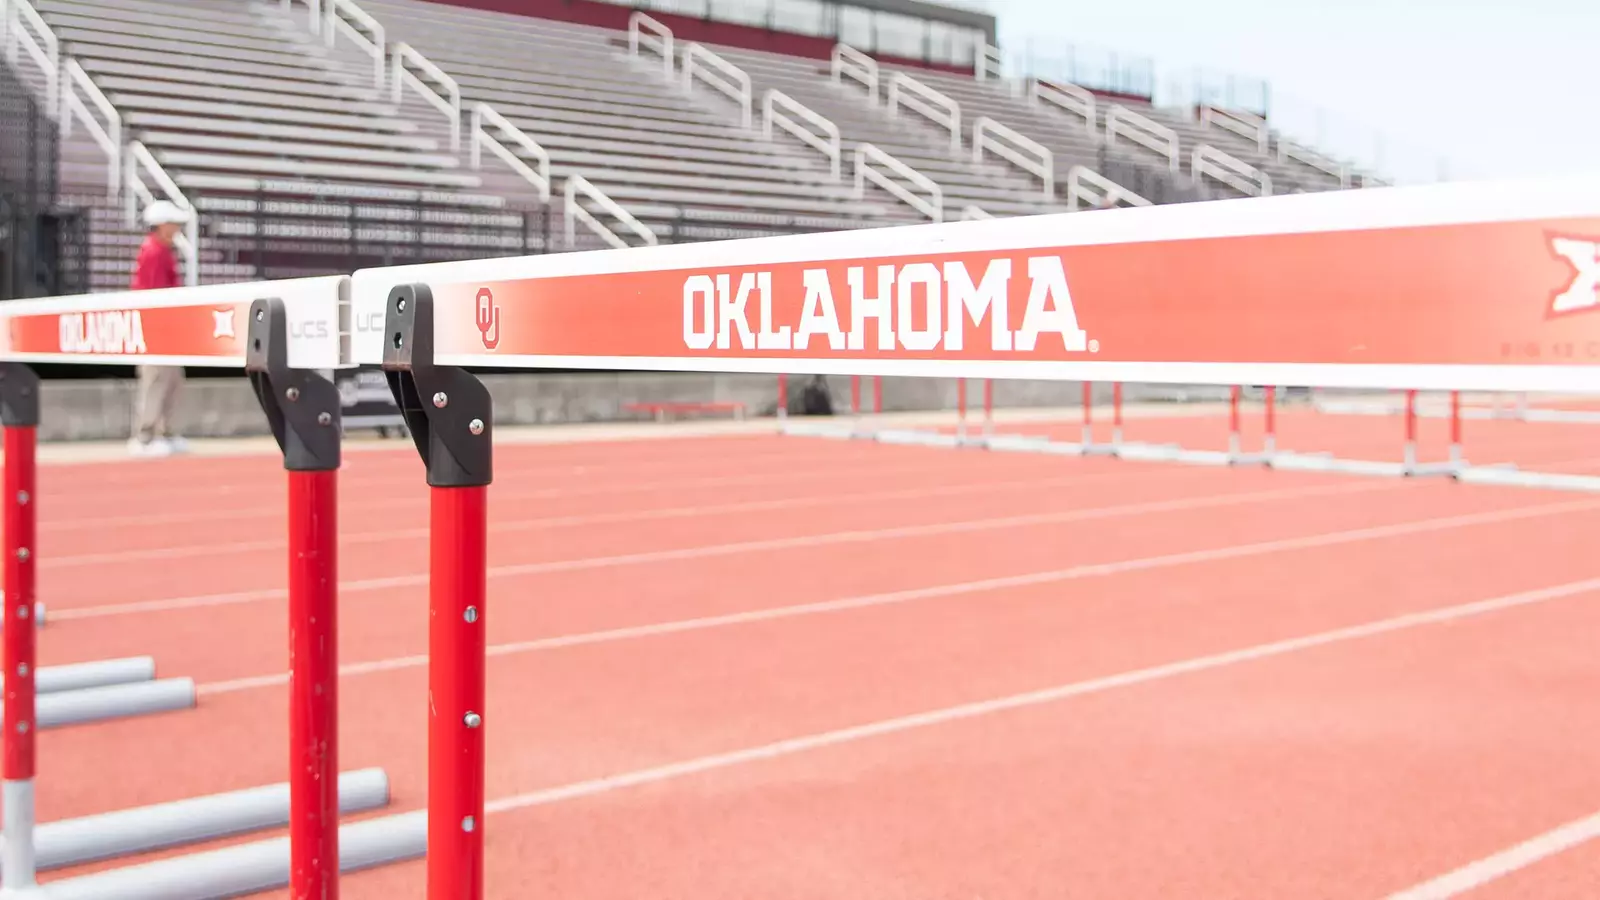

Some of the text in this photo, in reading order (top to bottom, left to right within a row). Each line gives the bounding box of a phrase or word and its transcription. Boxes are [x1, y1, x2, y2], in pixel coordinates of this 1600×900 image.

[683, 256, 1087, 352] OKLAHOMA
[58, 309, 147, 354] OKLAHOMA
[289, 320, 328, 339] UCS
[356, 312, 385, 332] UC
